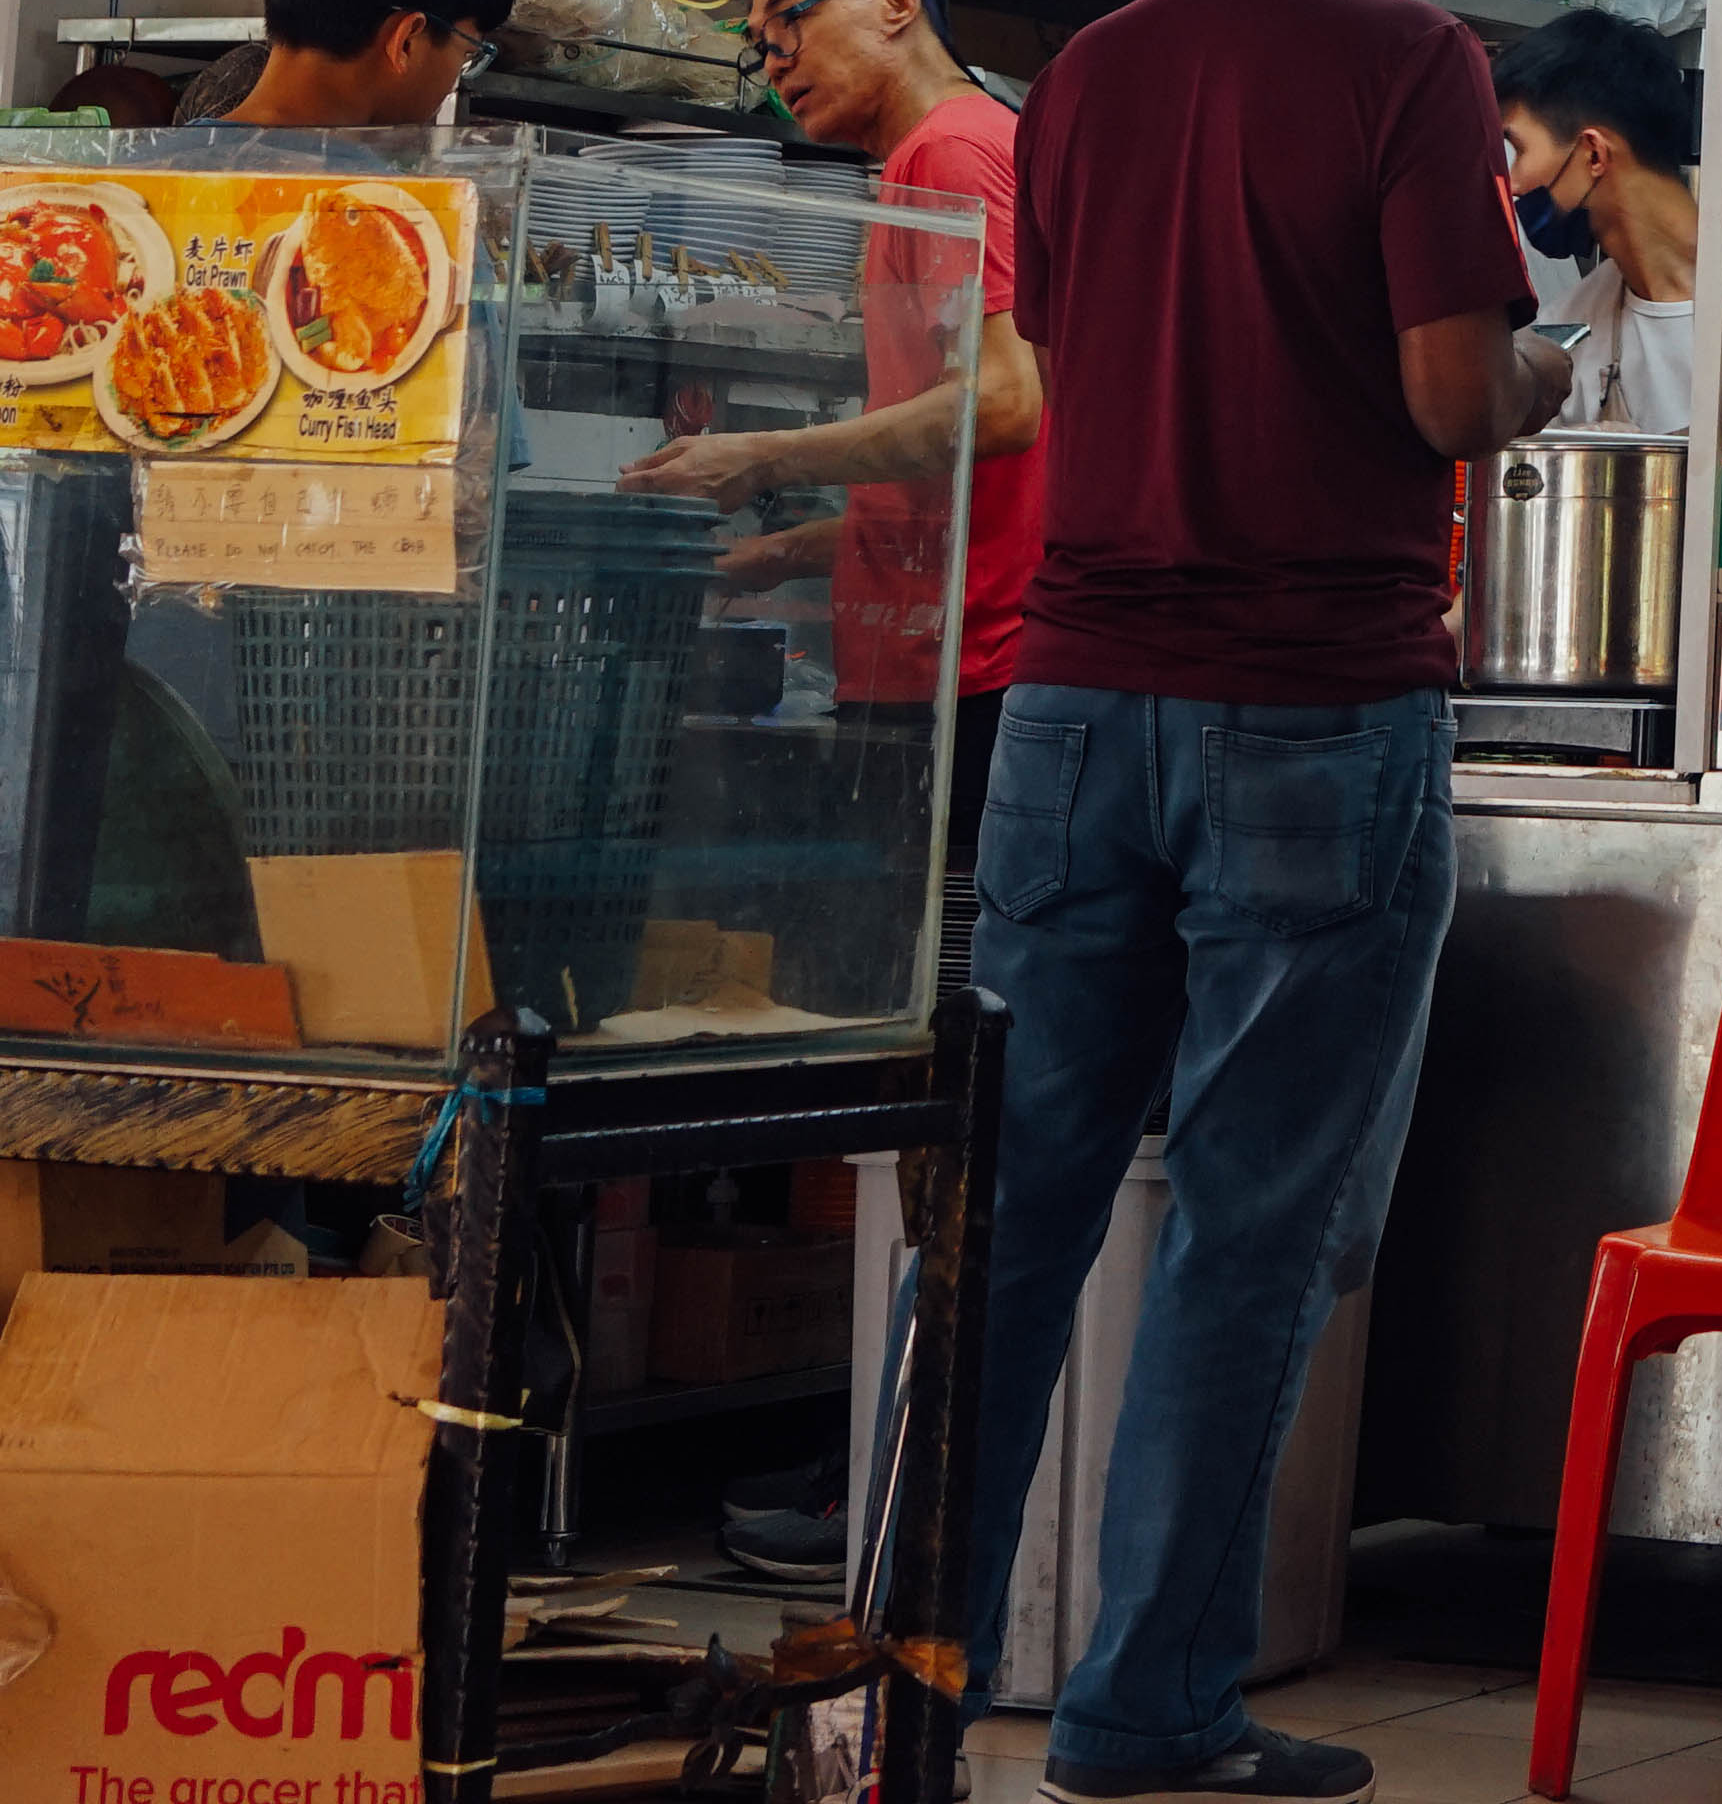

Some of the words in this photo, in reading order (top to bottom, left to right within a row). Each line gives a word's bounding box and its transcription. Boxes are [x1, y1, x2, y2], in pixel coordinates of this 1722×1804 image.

[187, 264, 206, 286] Oat
[210, 265, 247, 286] Prawn
[299, 413, 333, 442] Curry
[367, 415, 396, 439] Head
[104, 1626, 413, 1740] redm
[70, 1766, 154, 1804] The
